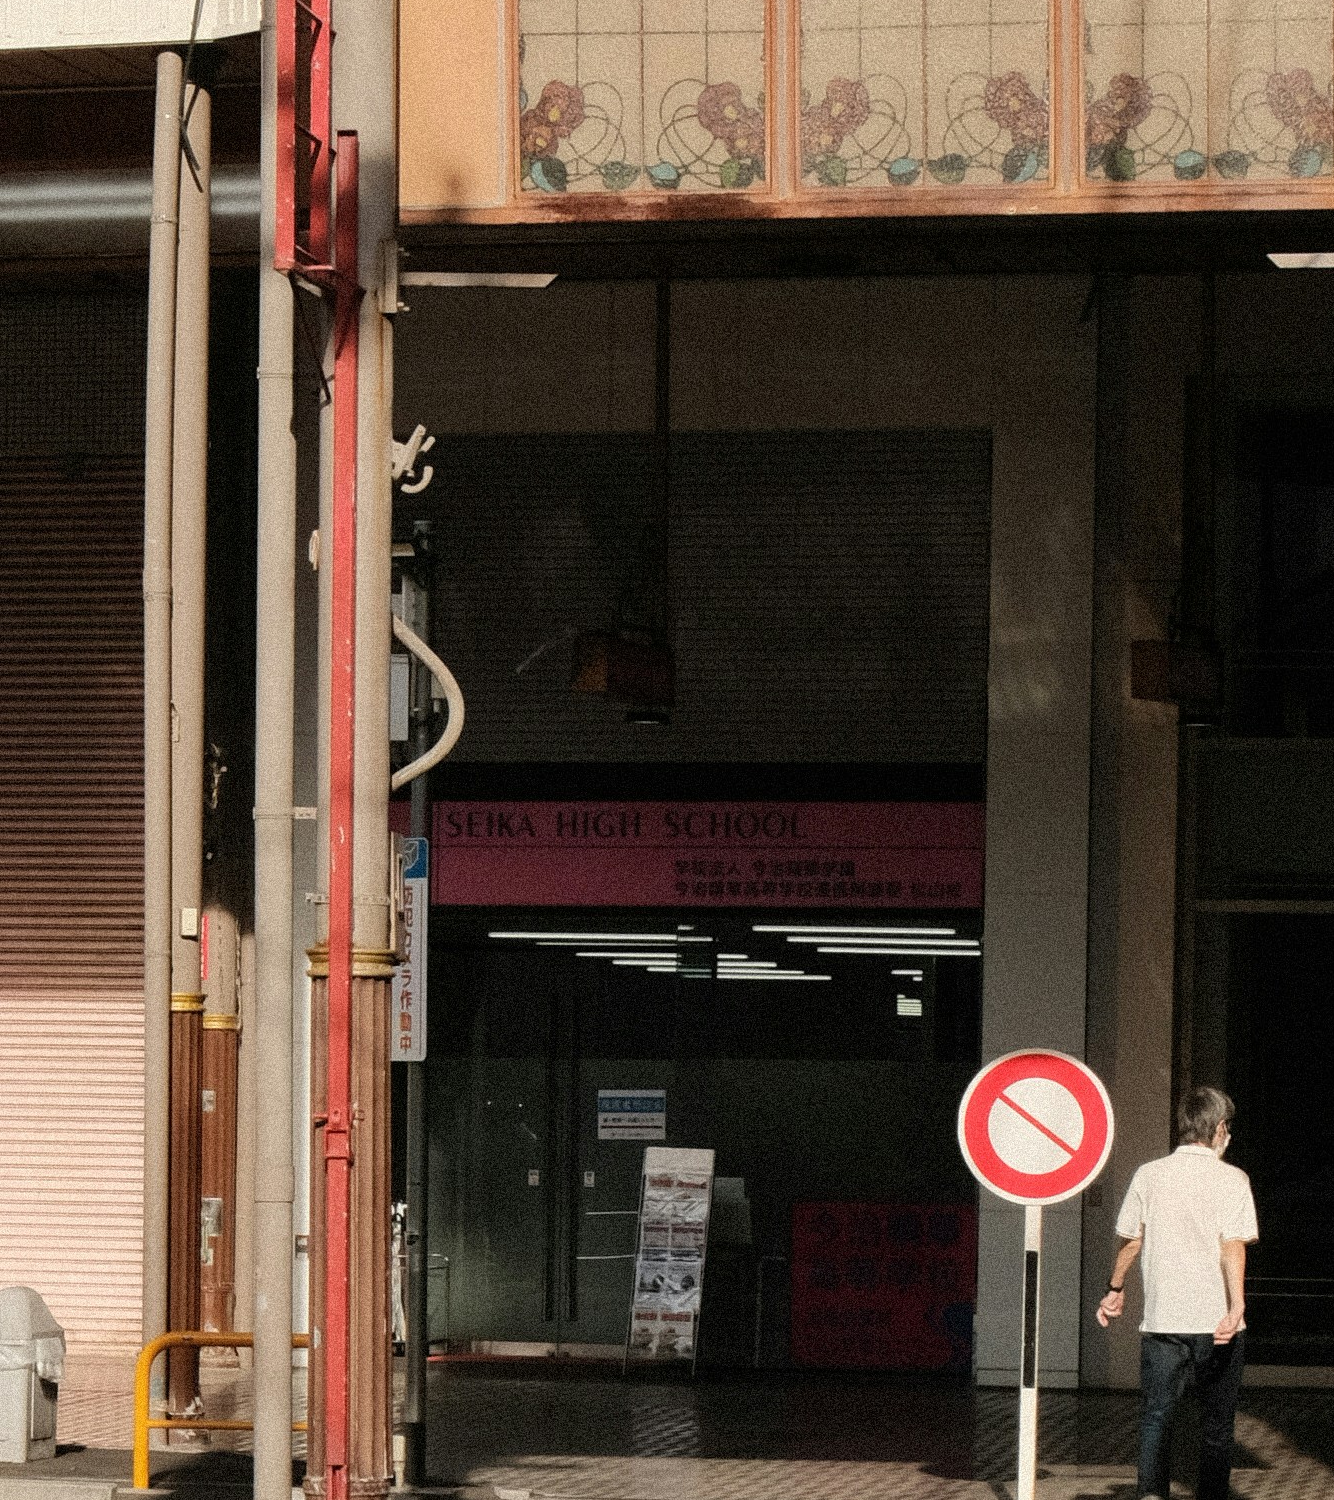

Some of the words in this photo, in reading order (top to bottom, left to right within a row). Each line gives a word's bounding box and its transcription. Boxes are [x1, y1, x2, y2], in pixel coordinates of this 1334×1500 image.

[446, 811, 536, 838] SEIKA
[555, 811, 643, 838] HIGH
[663, 810, 807, 839] SCHOOL
